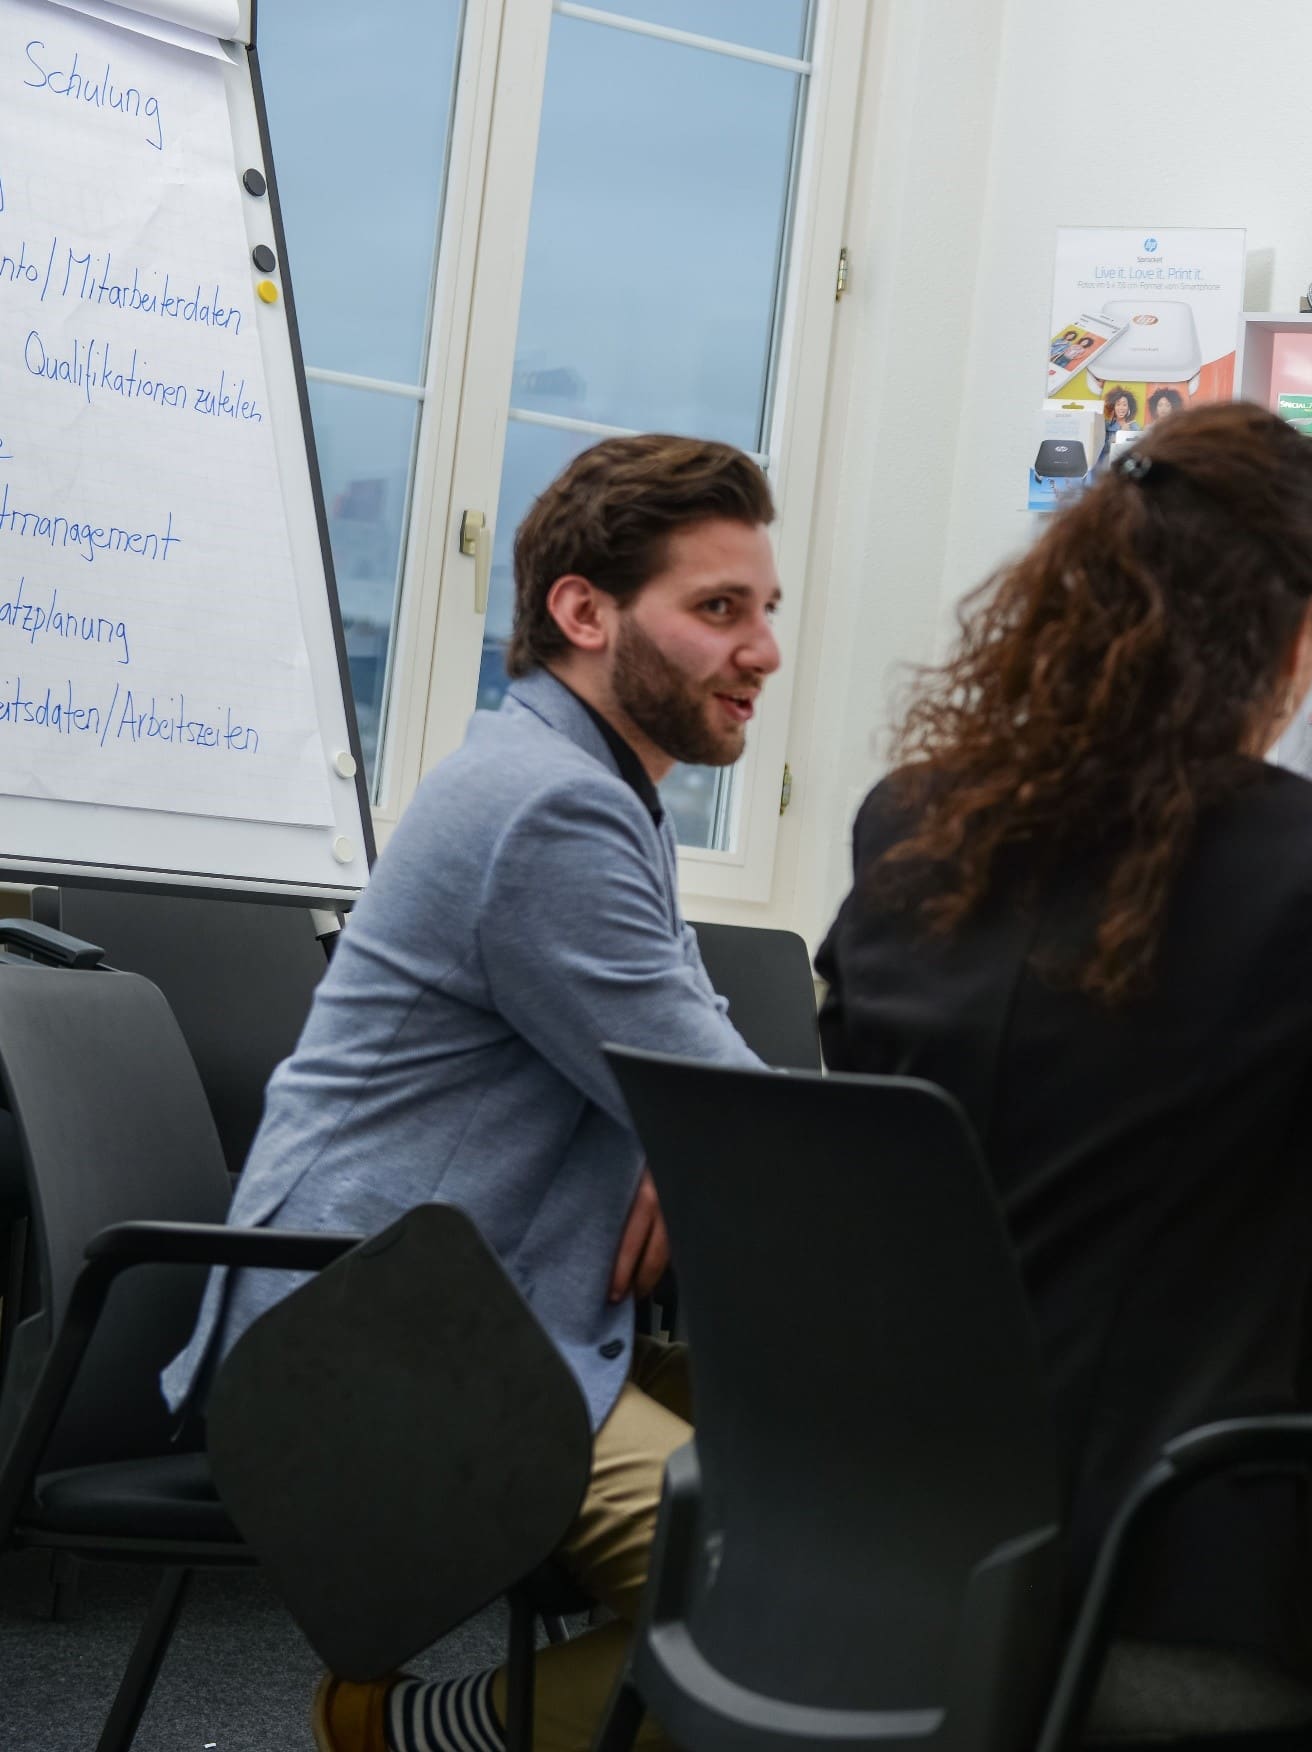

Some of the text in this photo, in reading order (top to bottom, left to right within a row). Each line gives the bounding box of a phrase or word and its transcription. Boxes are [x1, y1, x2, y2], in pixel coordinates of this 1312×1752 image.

[23, 40, 163, 150] Schulung
[1095, 267, 1116, 279] Live
[1129, 268, 1154, 279] Love
[1168, 268, 1193, 280] Print
[25, 331, 262, 422] Qualifikationen zuteilen
